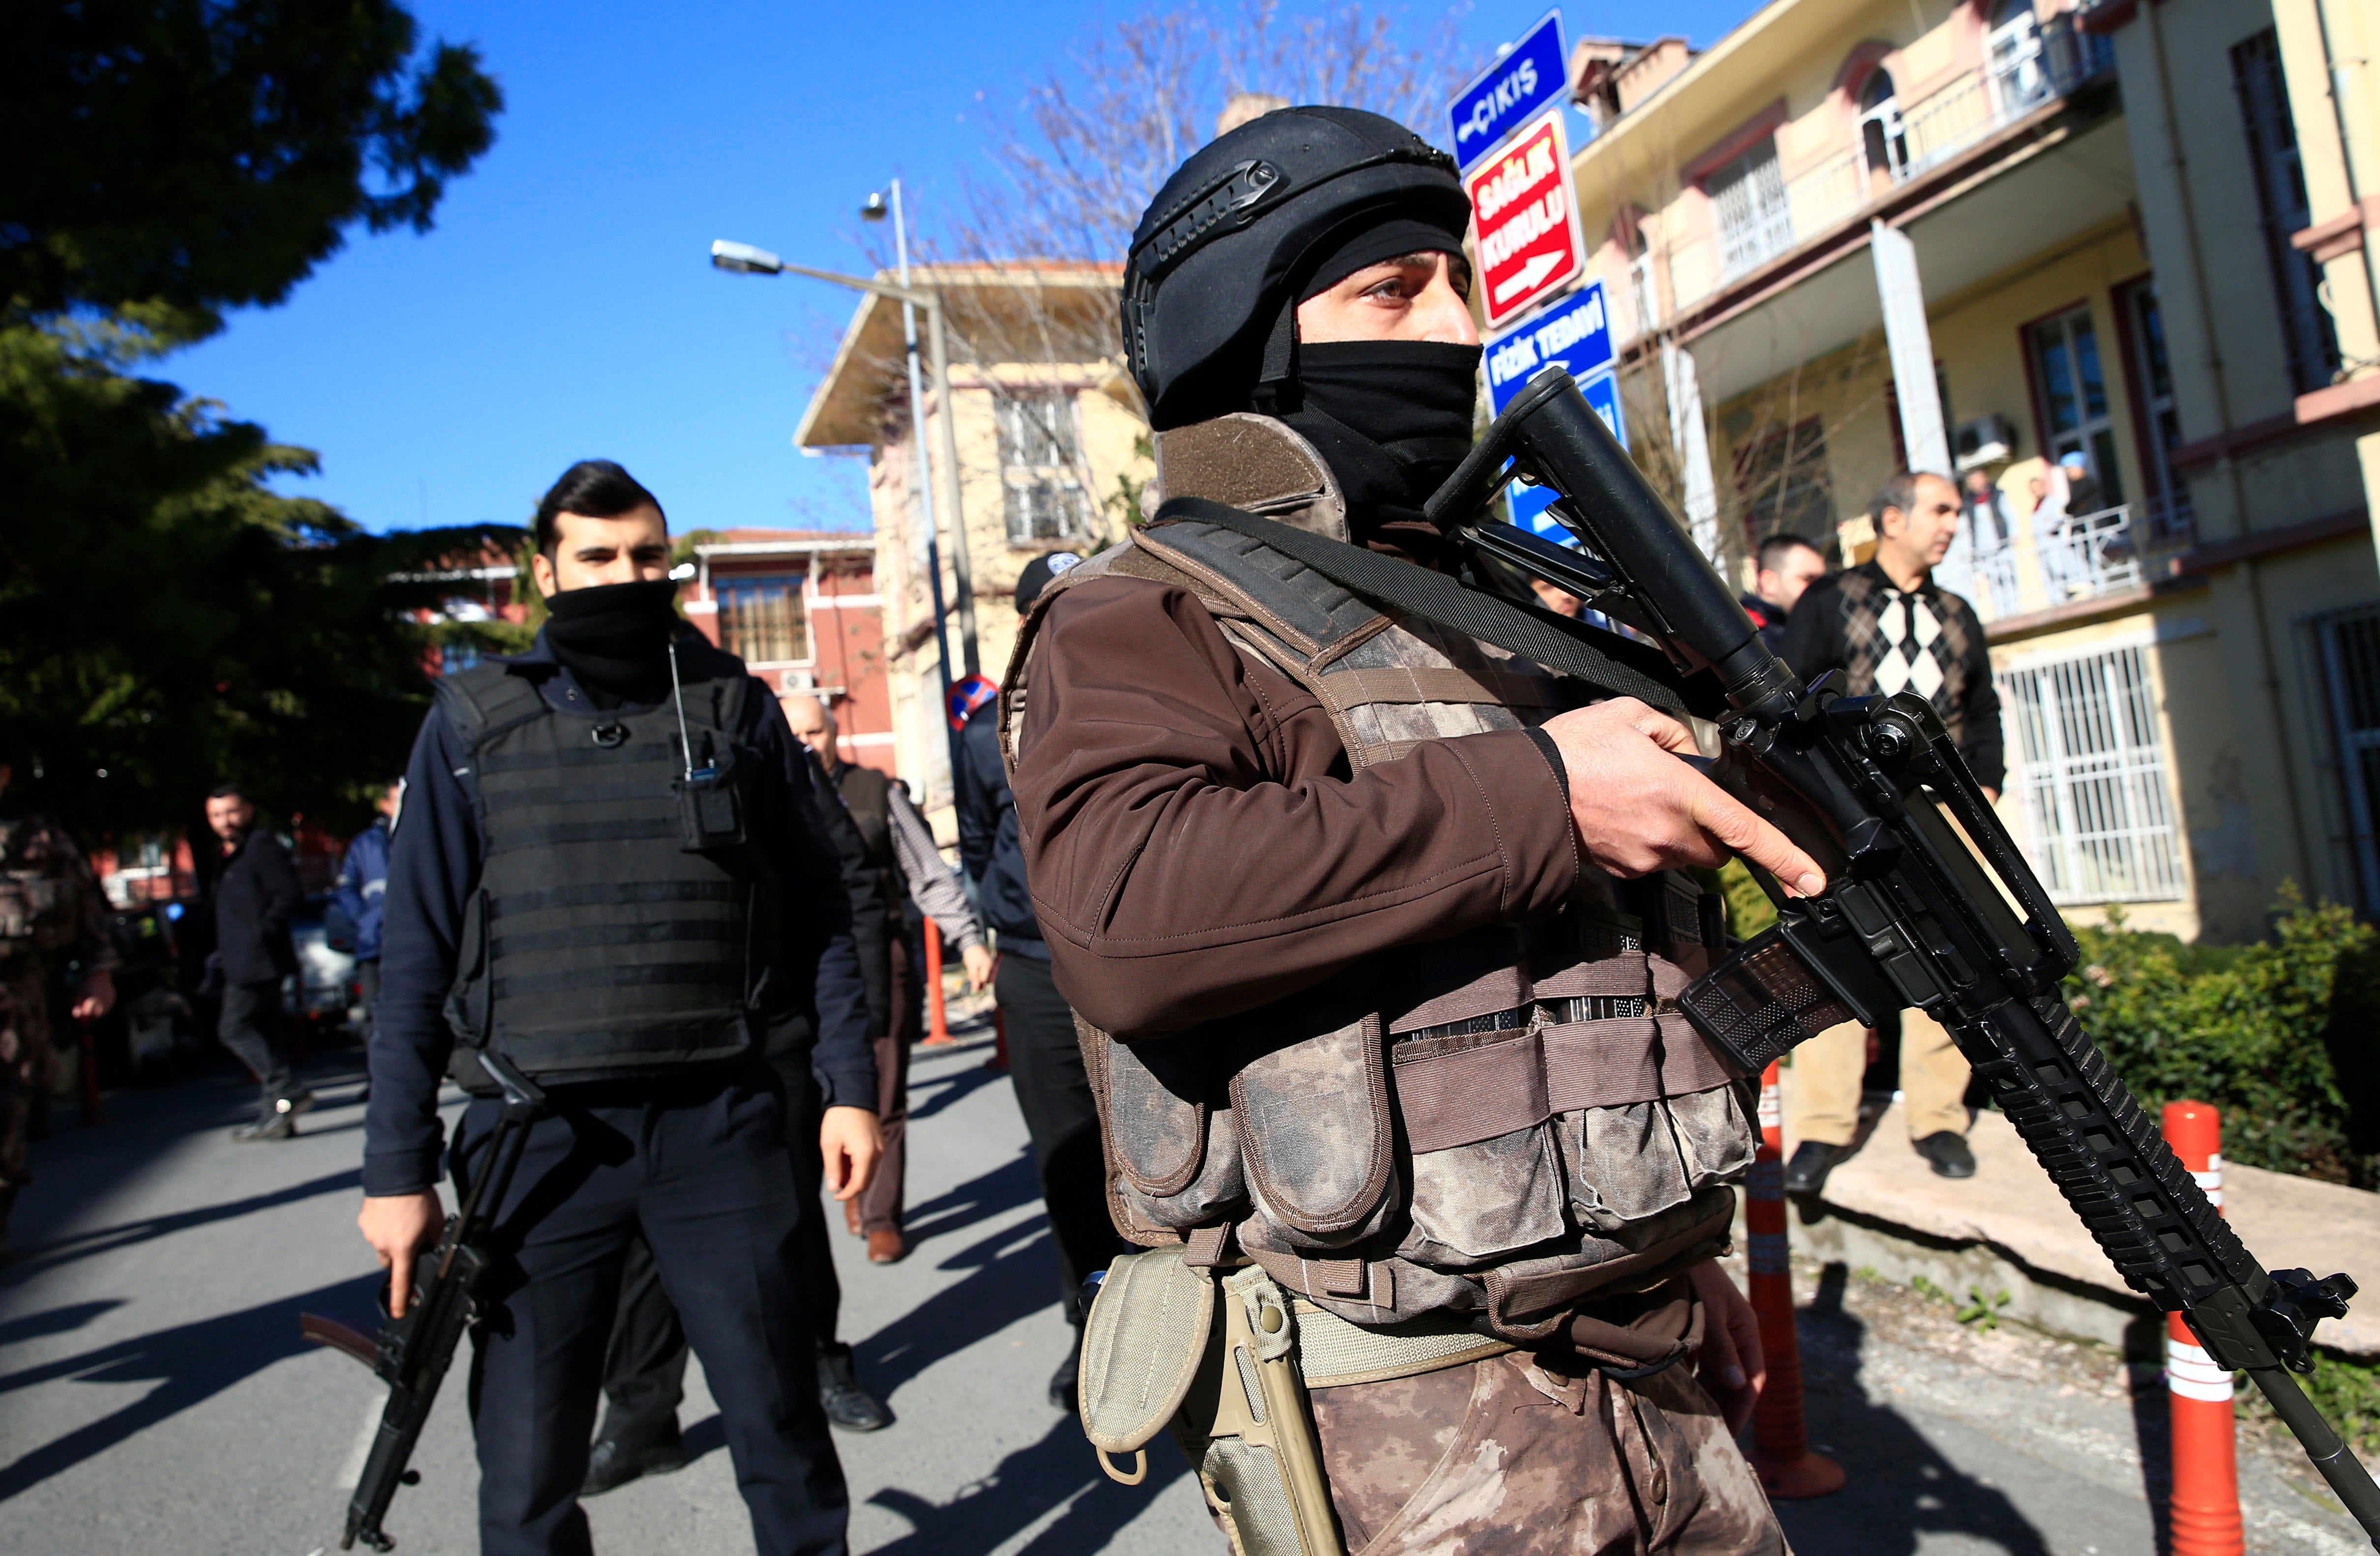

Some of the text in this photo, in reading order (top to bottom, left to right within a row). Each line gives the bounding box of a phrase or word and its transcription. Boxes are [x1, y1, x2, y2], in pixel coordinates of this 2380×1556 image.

[1473, 57, 1538, 136] ÇIKIŞ
[1477, 136, 1556, 220] SAĞLIK
[1480, 183, 1566, 272] KURULU
[1490, 290, 1604, 387] FİZİK TEDAVİ
